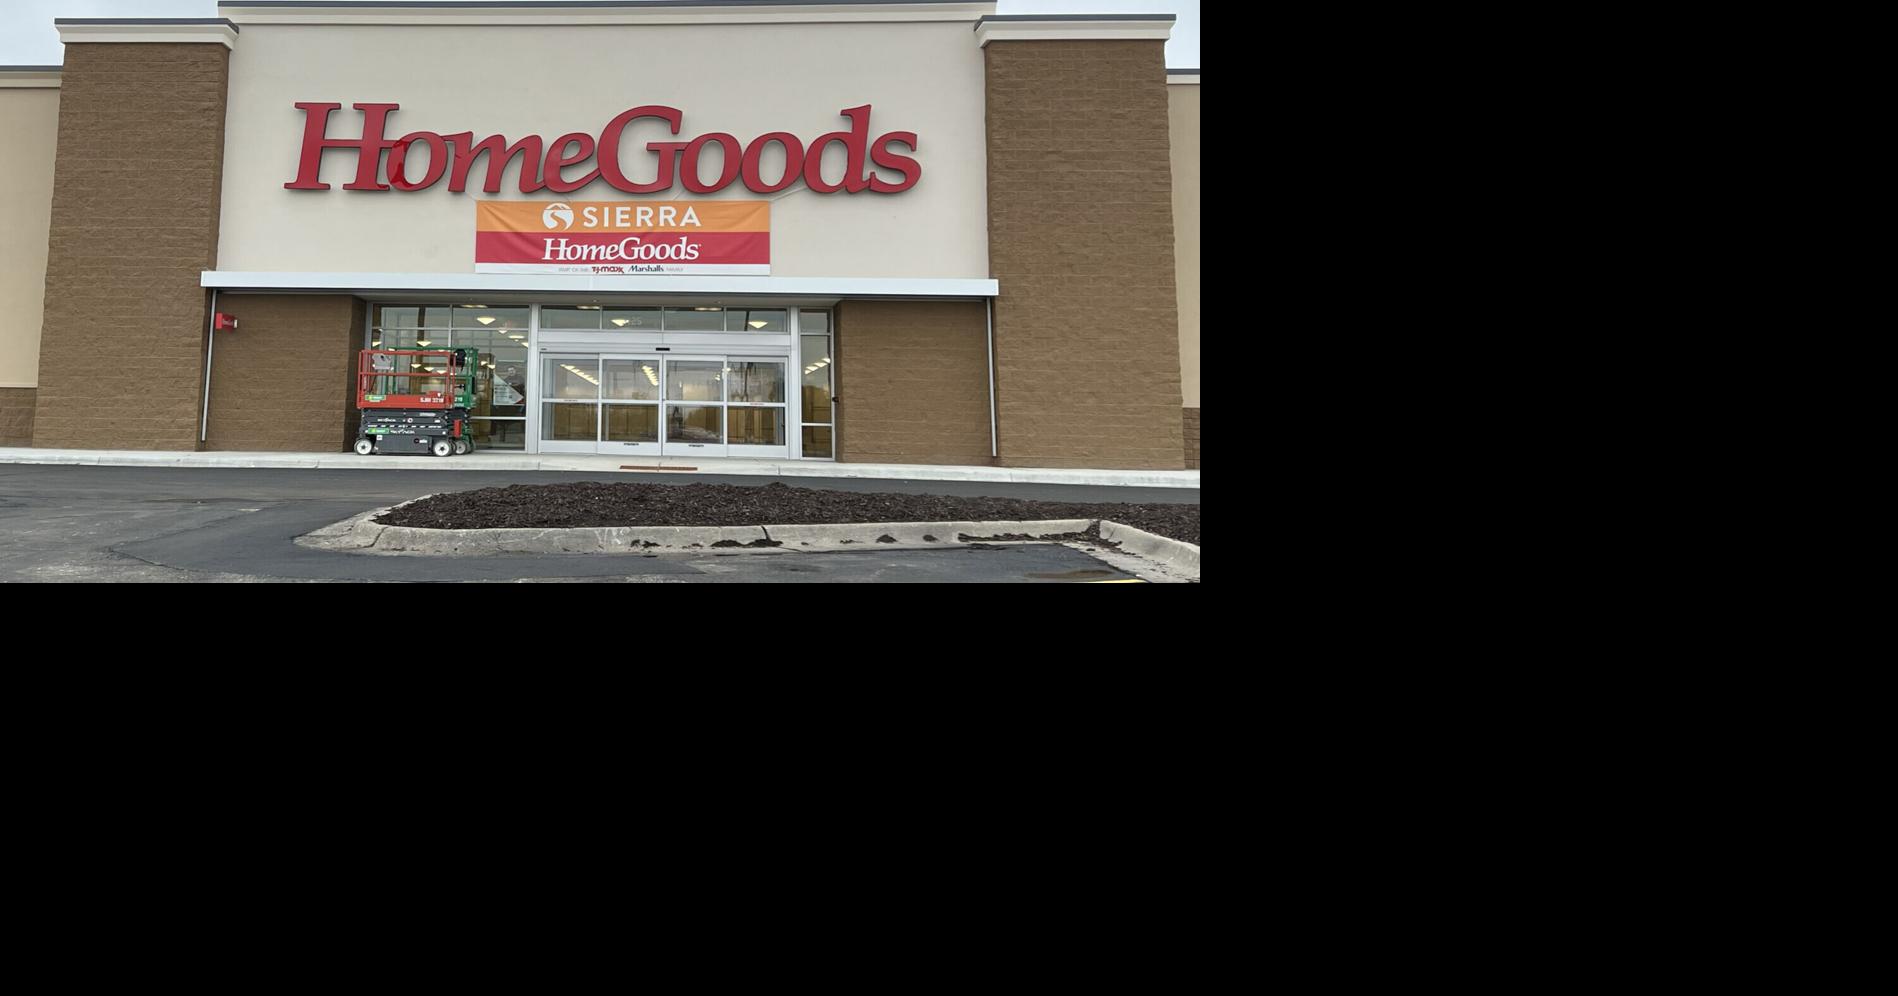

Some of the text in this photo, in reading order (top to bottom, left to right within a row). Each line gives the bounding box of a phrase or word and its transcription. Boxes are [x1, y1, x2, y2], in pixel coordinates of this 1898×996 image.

[283, 101, 923, 195] HomeGoods
[582, 205, 702, 228] SIERRA
[541, 235, 700, 261] HomeGoods
[628, 264, 665, 273] Marshalls
